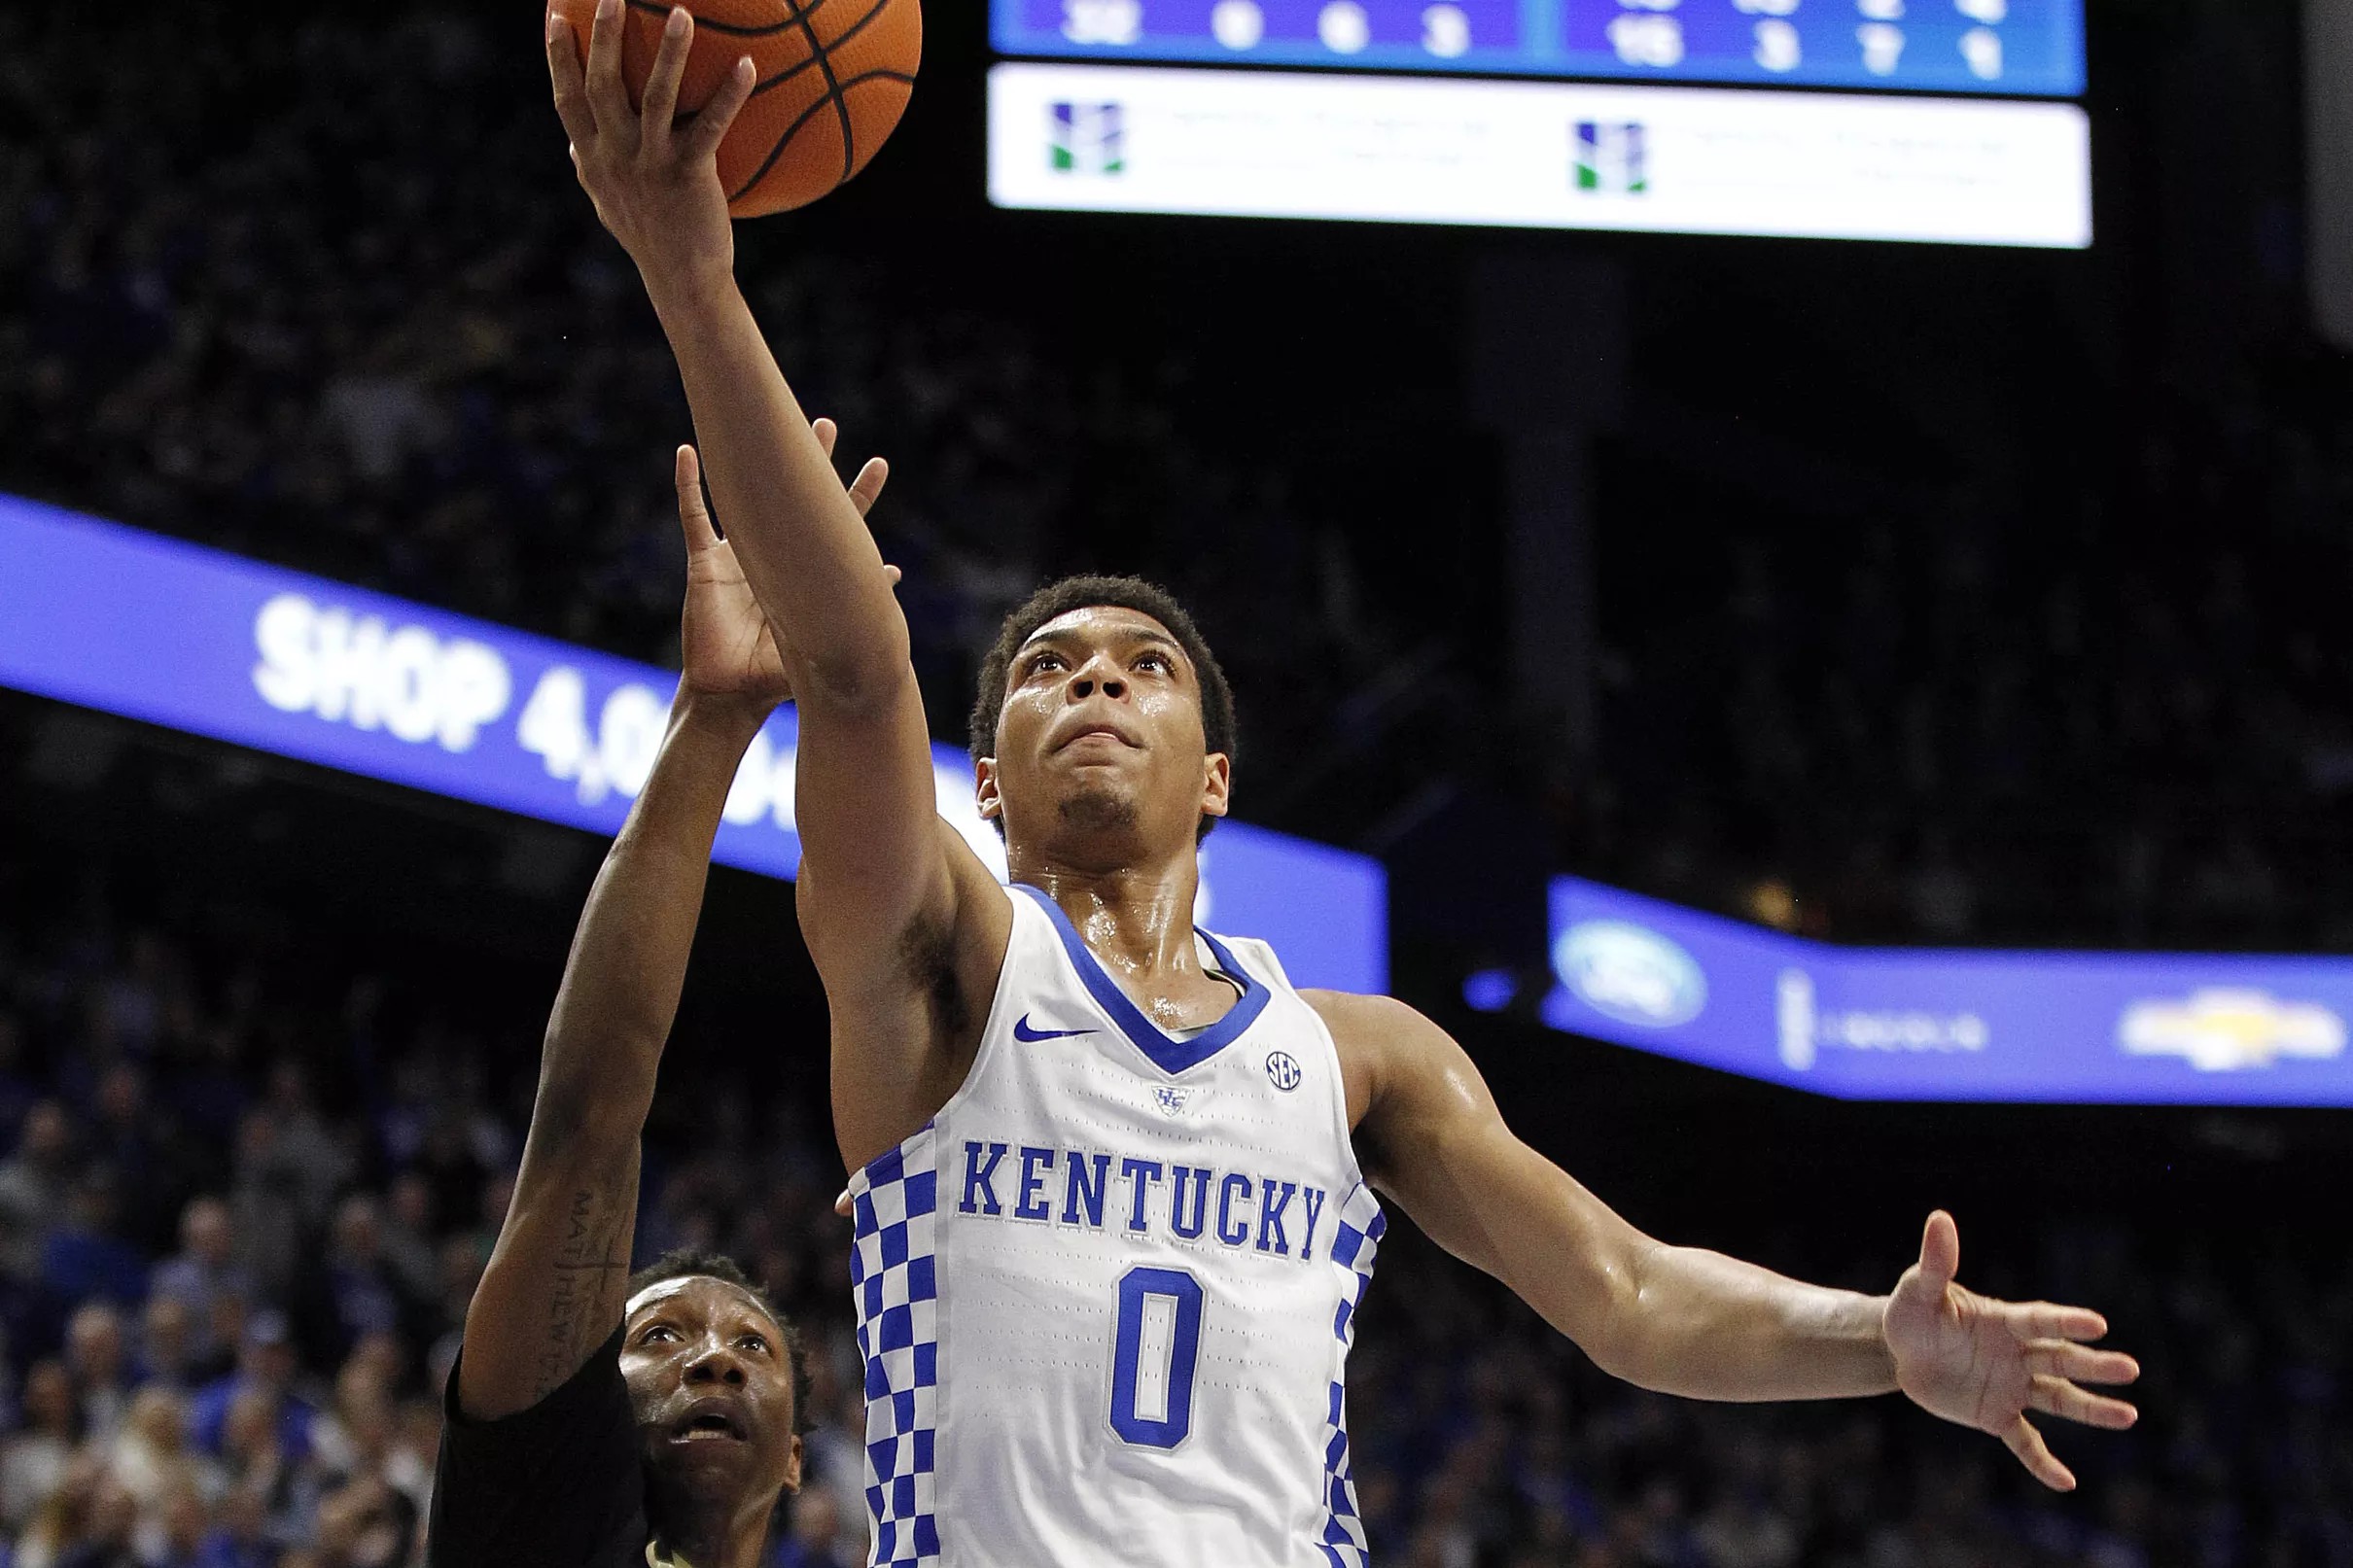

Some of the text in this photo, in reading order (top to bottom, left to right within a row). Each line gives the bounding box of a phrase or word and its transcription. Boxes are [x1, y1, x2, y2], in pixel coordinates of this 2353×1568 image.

[253, 593, 511, 753] SHOP
[1267, 1052, 1301, 1090] SEC
[957, 1139, 1326, 1262] KENTUCKY
[1106, 1265, 1208, 1452] 0
